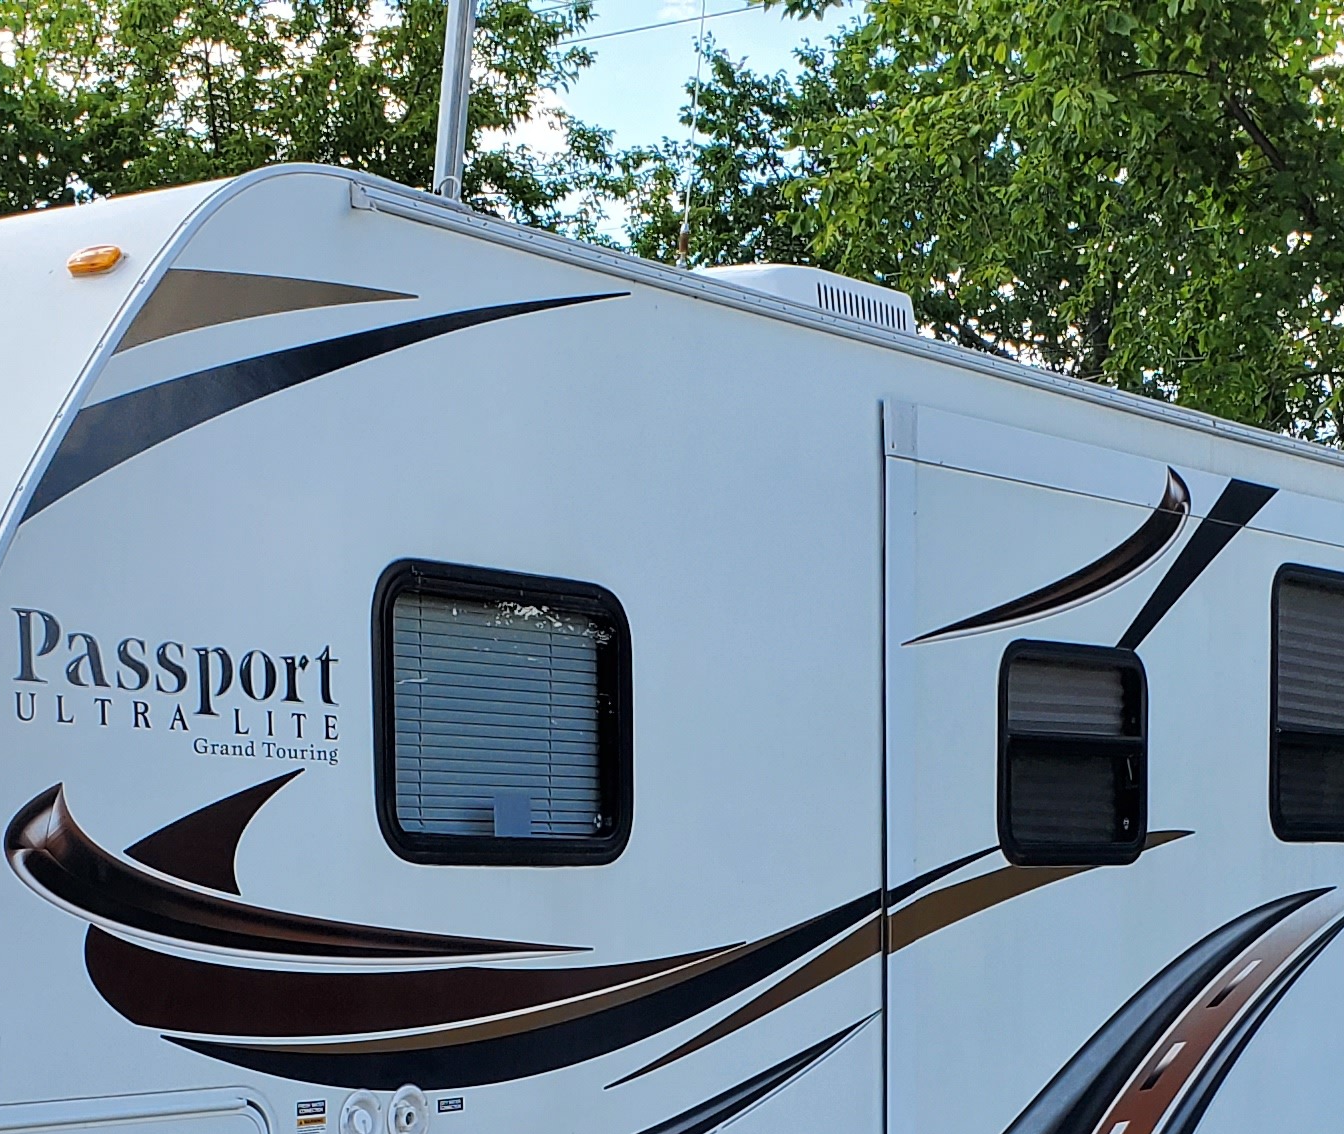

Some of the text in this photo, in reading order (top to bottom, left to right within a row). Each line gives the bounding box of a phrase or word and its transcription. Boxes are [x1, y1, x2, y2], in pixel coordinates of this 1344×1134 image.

[11, 607, 340, 716] Passport
[14, 691, 340, 741] ULTRA LITE
[193, 738, 339, 766] Grand Touring
